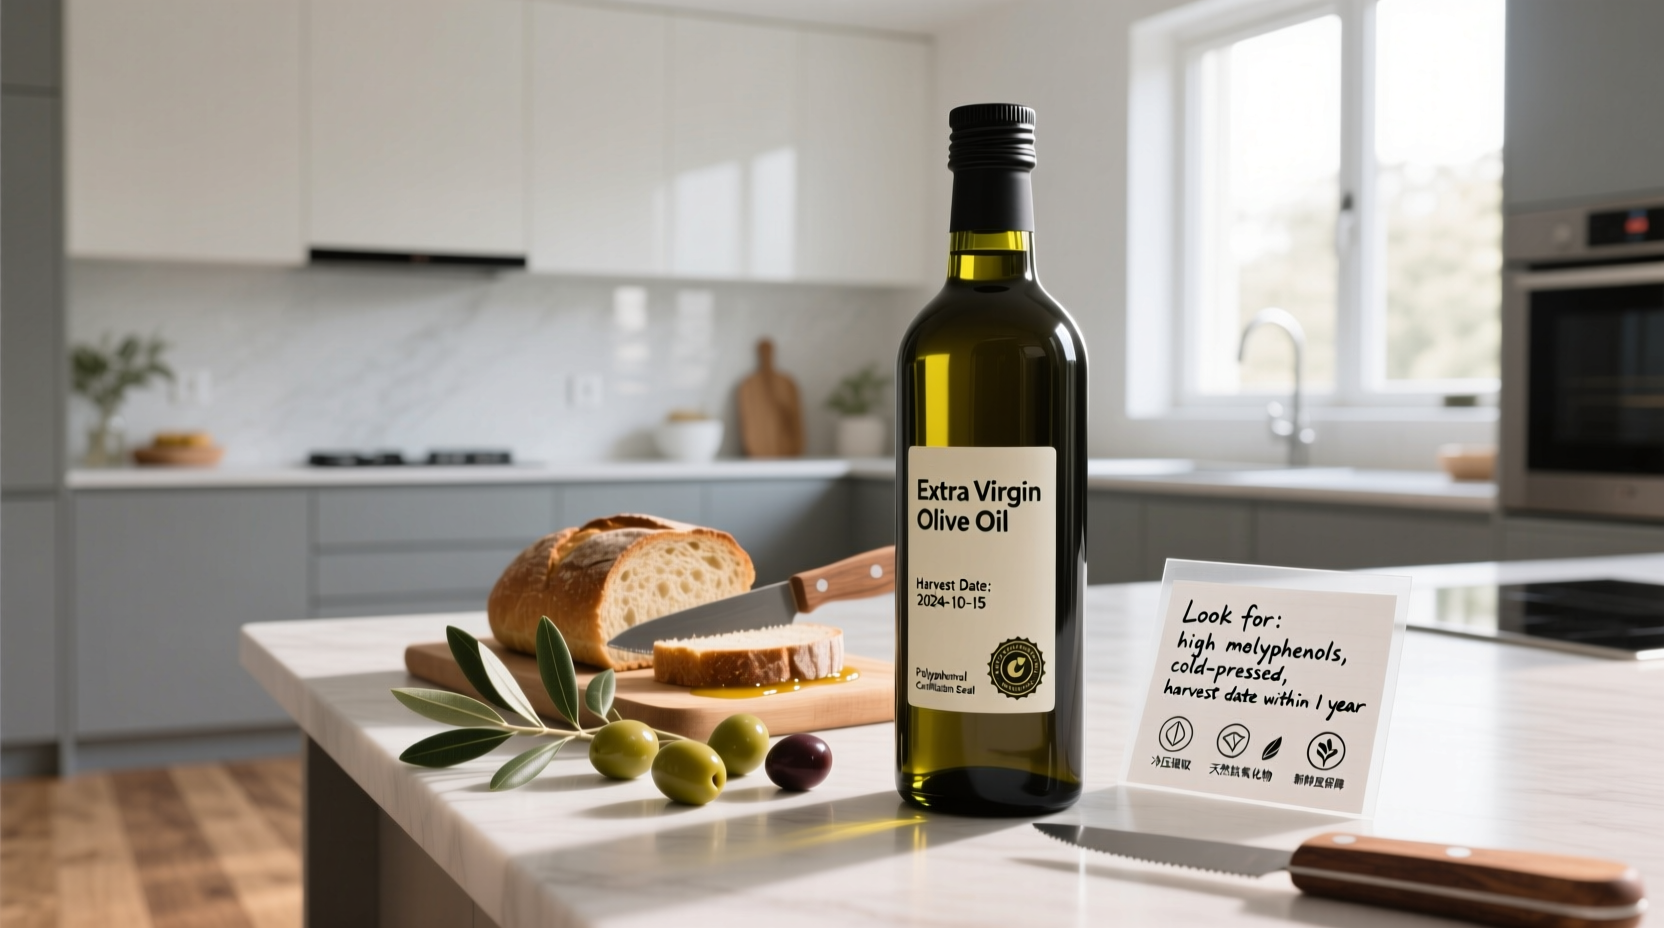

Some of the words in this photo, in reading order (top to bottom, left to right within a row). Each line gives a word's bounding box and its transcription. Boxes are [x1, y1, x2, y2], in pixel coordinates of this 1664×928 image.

[917, 478, 970, 502] Extra
[973, 479, 1042, 508] Virgin
[916, 507, 970, 532] Olive
[975, 509, 1009, 533] Oil
[916, 577, 956, 592] Harvest
[959, 578, 992, 593] Date:
[916, 593, 987, 610] 2024-10-15
[1181, 598, 1233, 626] Look
[1240, 603, 1283, 633] for:
[1176, 630, 1216, 659] high
[1170, 657, 1288, 687] cold-pressed,
[955, 684, 976, 696] Seal
[1163, 678, 1221, 701] harvest
[1223, 685, 1259, 705] date
[1263, 689, 1310, 709] within
[1325, 698, 1368, 722] year
